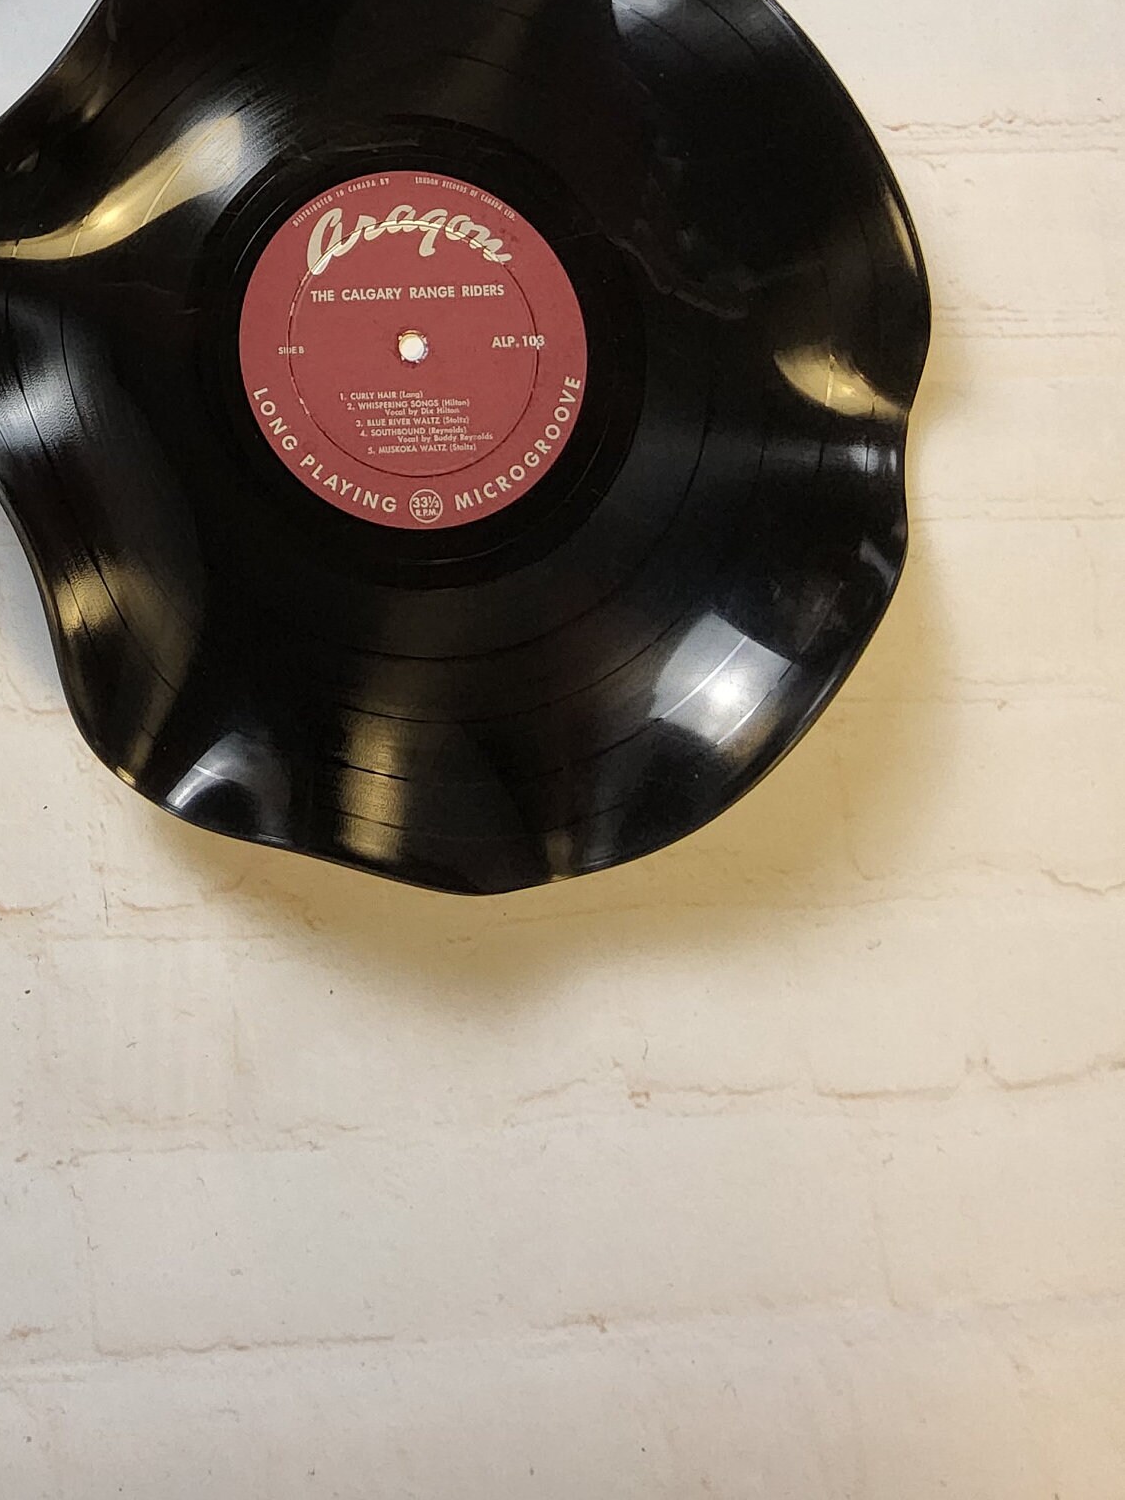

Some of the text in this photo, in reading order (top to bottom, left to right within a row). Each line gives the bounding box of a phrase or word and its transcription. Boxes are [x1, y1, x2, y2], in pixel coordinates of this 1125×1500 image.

[292, 194, 333, 228] DISTRIBUTED
[347, 178, 377, 192] CANADA
[306, 204, 512, 275] Aragon
[311, 284, 505, 302] THE CALGARY RANGE RIDERS
[522, 335, 545, 347] 103
[298, 346, 305, 354] B
[339, 392, 347, 400] 1.
[350, 392, 375, 400] CURLY
[347, 398, 469, 410] 2. WHISPERING SONGS (Hilton)
[385, 408, 405, 416] Vocal
[408, 408, 418, 416] by
[436, 406, 460, 414] Hilton
[355, 420, 363, 428] 3.
[367, 419, 386, 427] BLUE
[389, 418, 411, 426] RIVER
[413, 417, 441, 425] WALTZ
[371, 428, 425, 436] SOUTHBOUND
[429, 426, 467, 435] (Reynolds)
[397, 432, 493, 443] Vocal by Buddy Reynolds
[253, 376, 581, 512] LONG PLAYING MICROGROOVE
[367, 446, 375, 454] 5.
[379, 445, 417, 454] MUSKOKA
[419, 444, 447, 452] WALTZ
